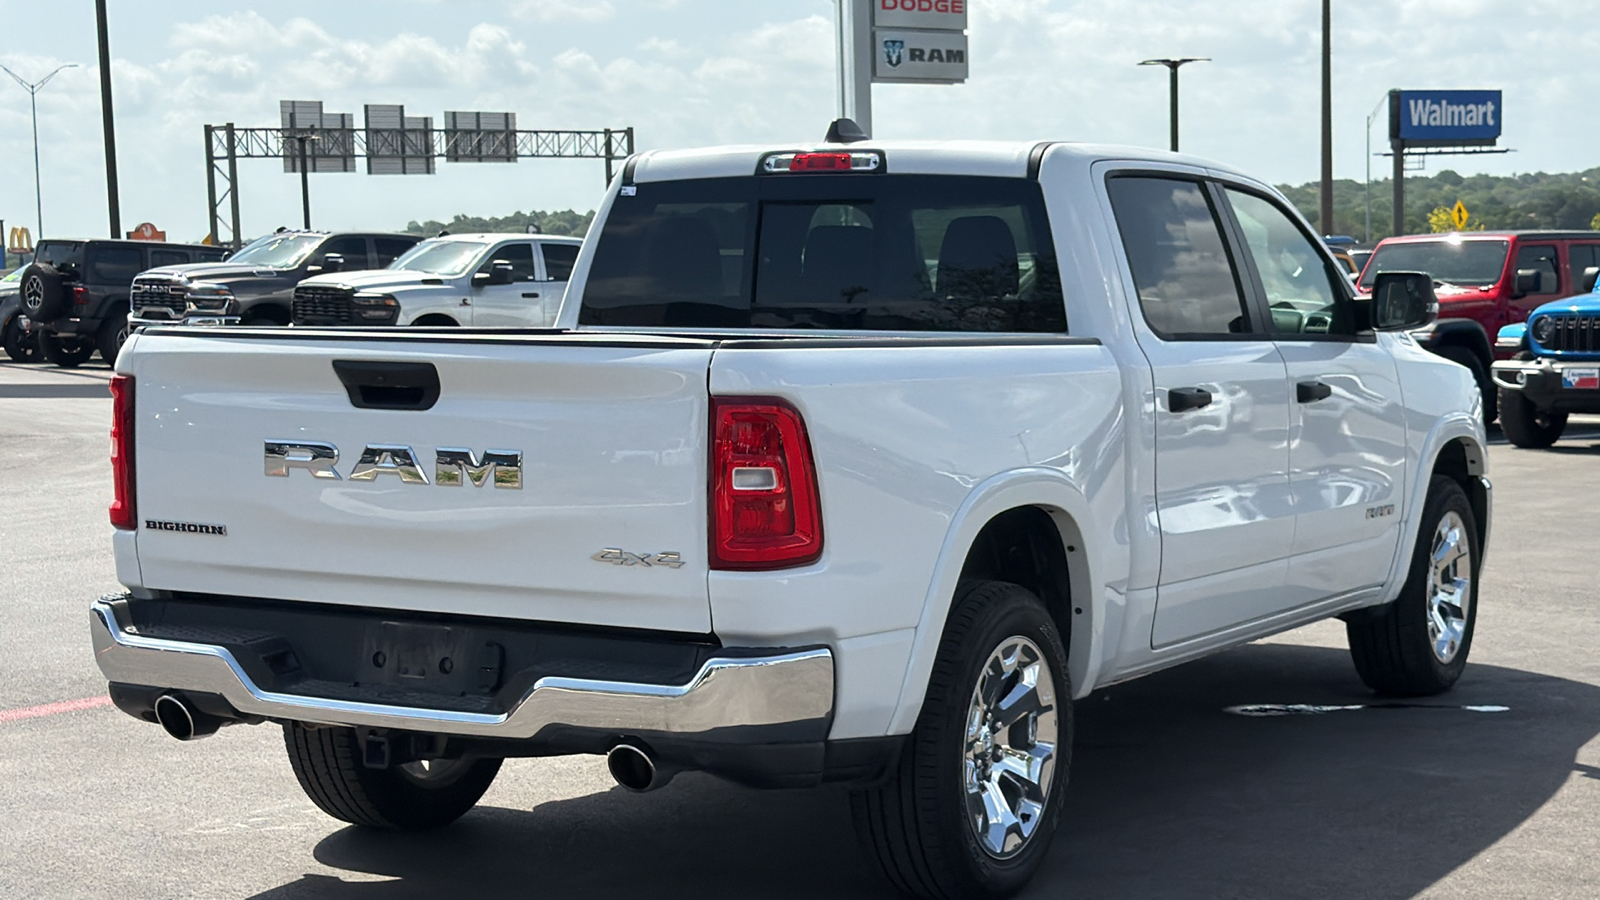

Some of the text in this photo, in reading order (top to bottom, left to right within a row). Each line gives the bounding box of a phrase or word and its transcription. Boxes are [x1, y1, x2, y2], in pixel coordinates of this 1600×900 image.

[881, 0, 964, 14] DODGE
[909, 48, 964, 63] RAM
[1409, 99, 1495, 126] Walmart
[264, 439, 524, 490] RAM
[145, 520, 224, 535] BIGHORN
